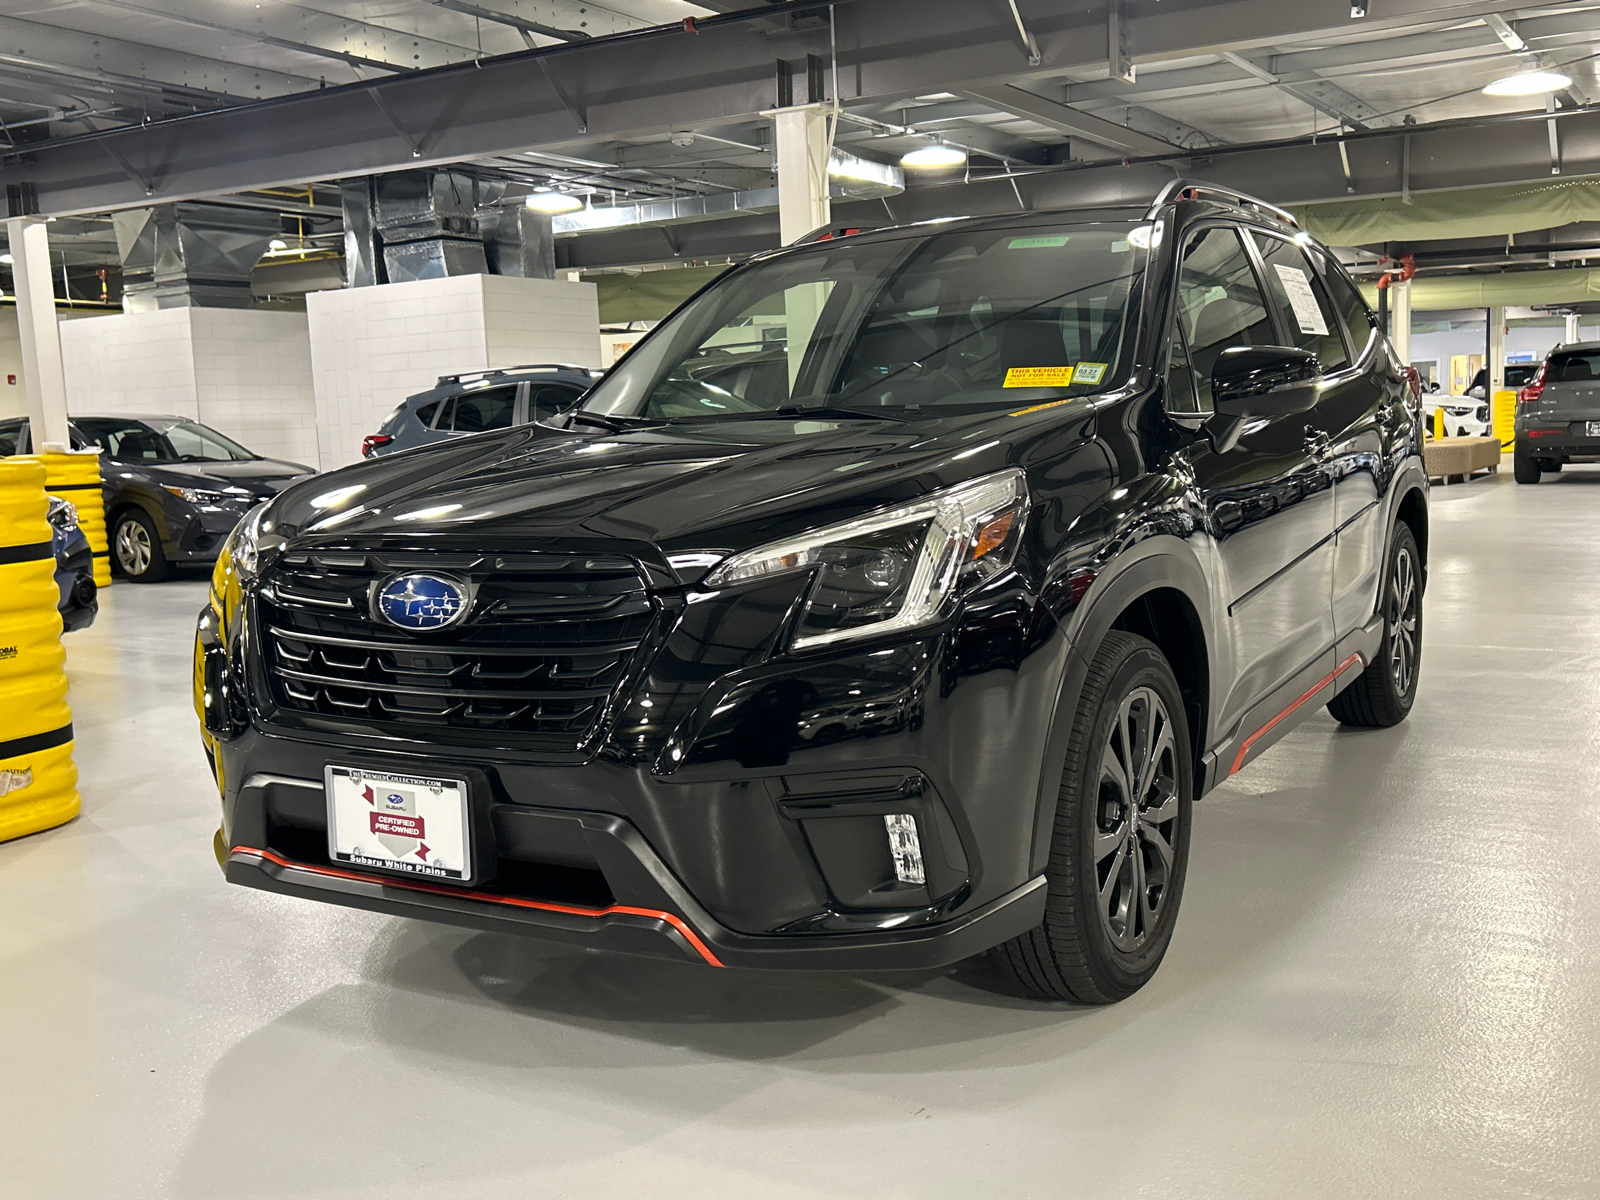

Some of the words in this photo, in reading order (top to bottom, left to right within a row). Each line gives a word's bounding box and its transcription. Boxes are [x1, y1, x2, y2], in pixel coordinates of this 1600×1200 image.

[385, 804, 407, 812] SUBARU
[378, 816, 416, 827] CERTIFIED
[375, 823, 420, 836] PRE-OWNED
[350, 855, 383, 867] Subaru
[384, 859, 413, 871] White
[415, 864, 447, 876] Plains
